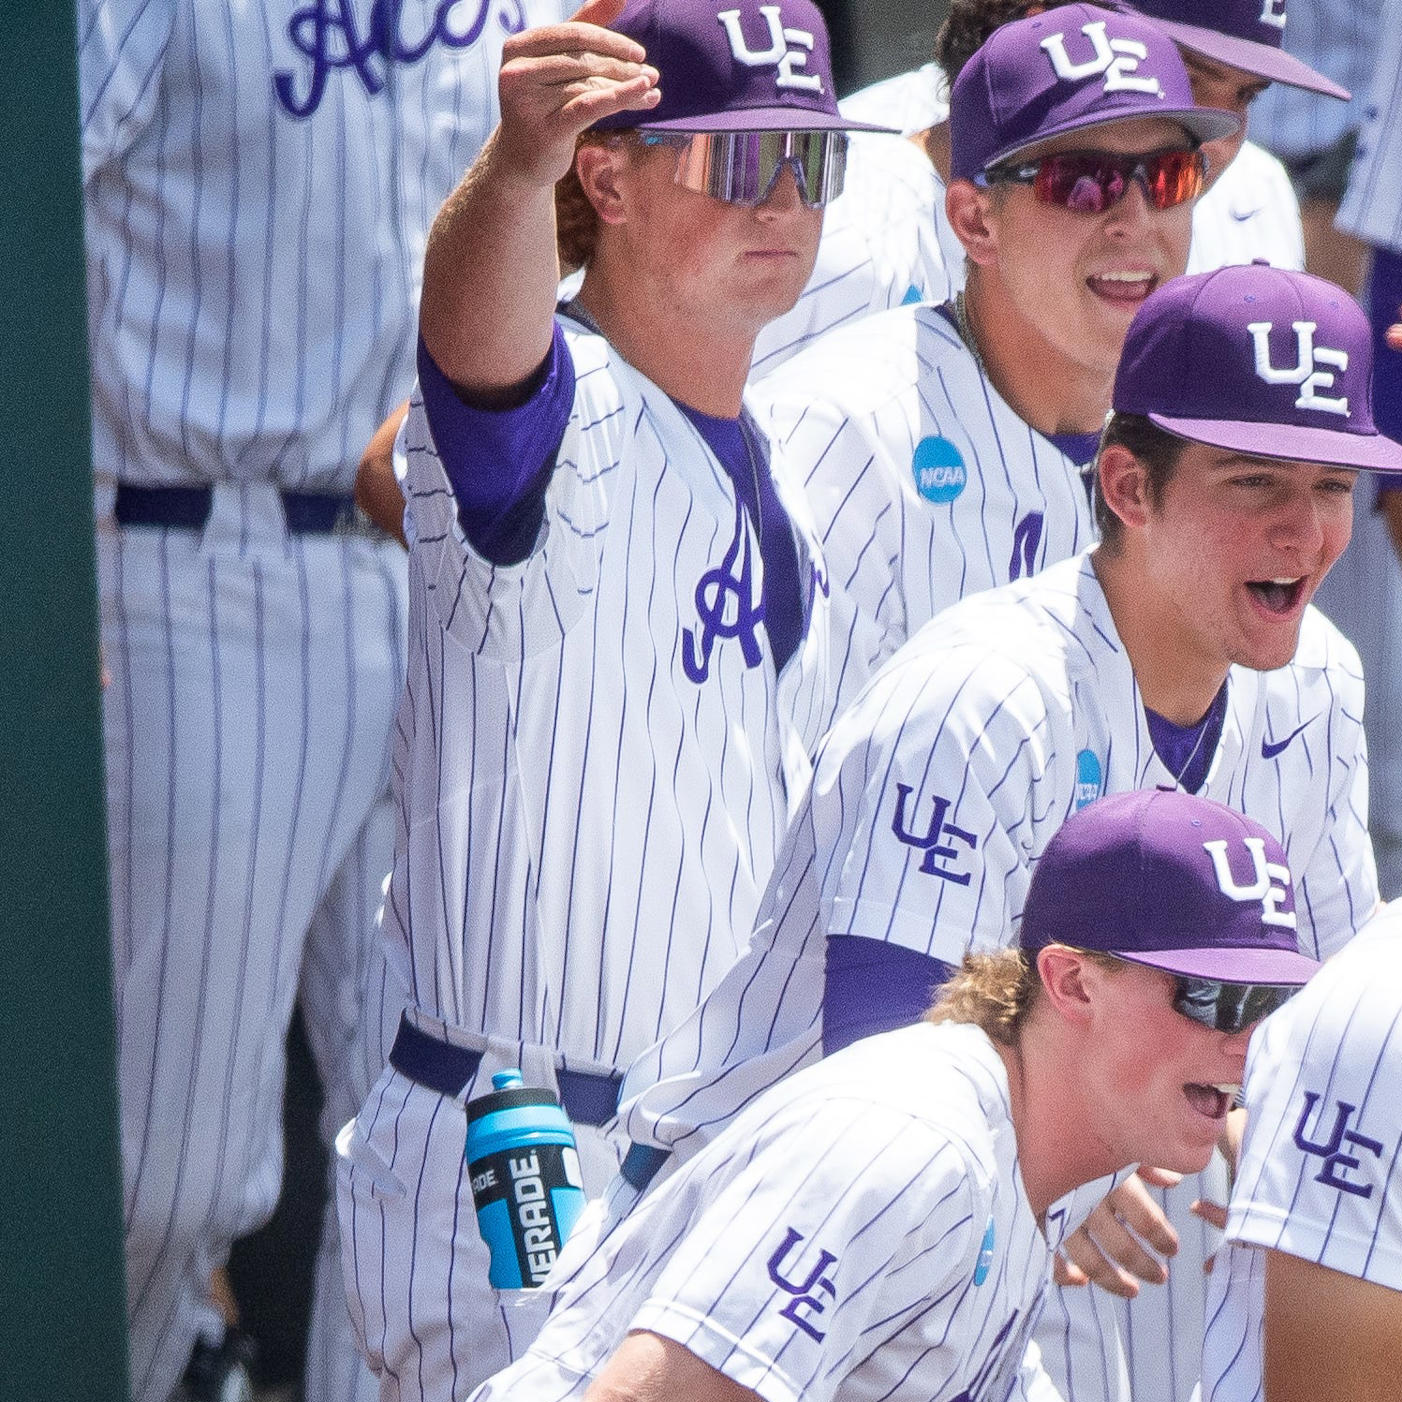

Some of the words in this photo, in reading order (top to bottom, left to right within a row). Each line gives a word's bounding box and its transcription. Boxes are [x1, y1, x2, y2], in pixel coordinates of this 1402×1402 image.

[718, 5, 822, 91] UE
[1040, 21, 1158, 94] UE
[1247, 321, 1349, 416] UE
[892, 783, 977, 886] UE
[1204, 837, 1295, 926] UE
[1293, 1091, 1384, 1199] UE
[767, 1227, 838, 1343] UE
